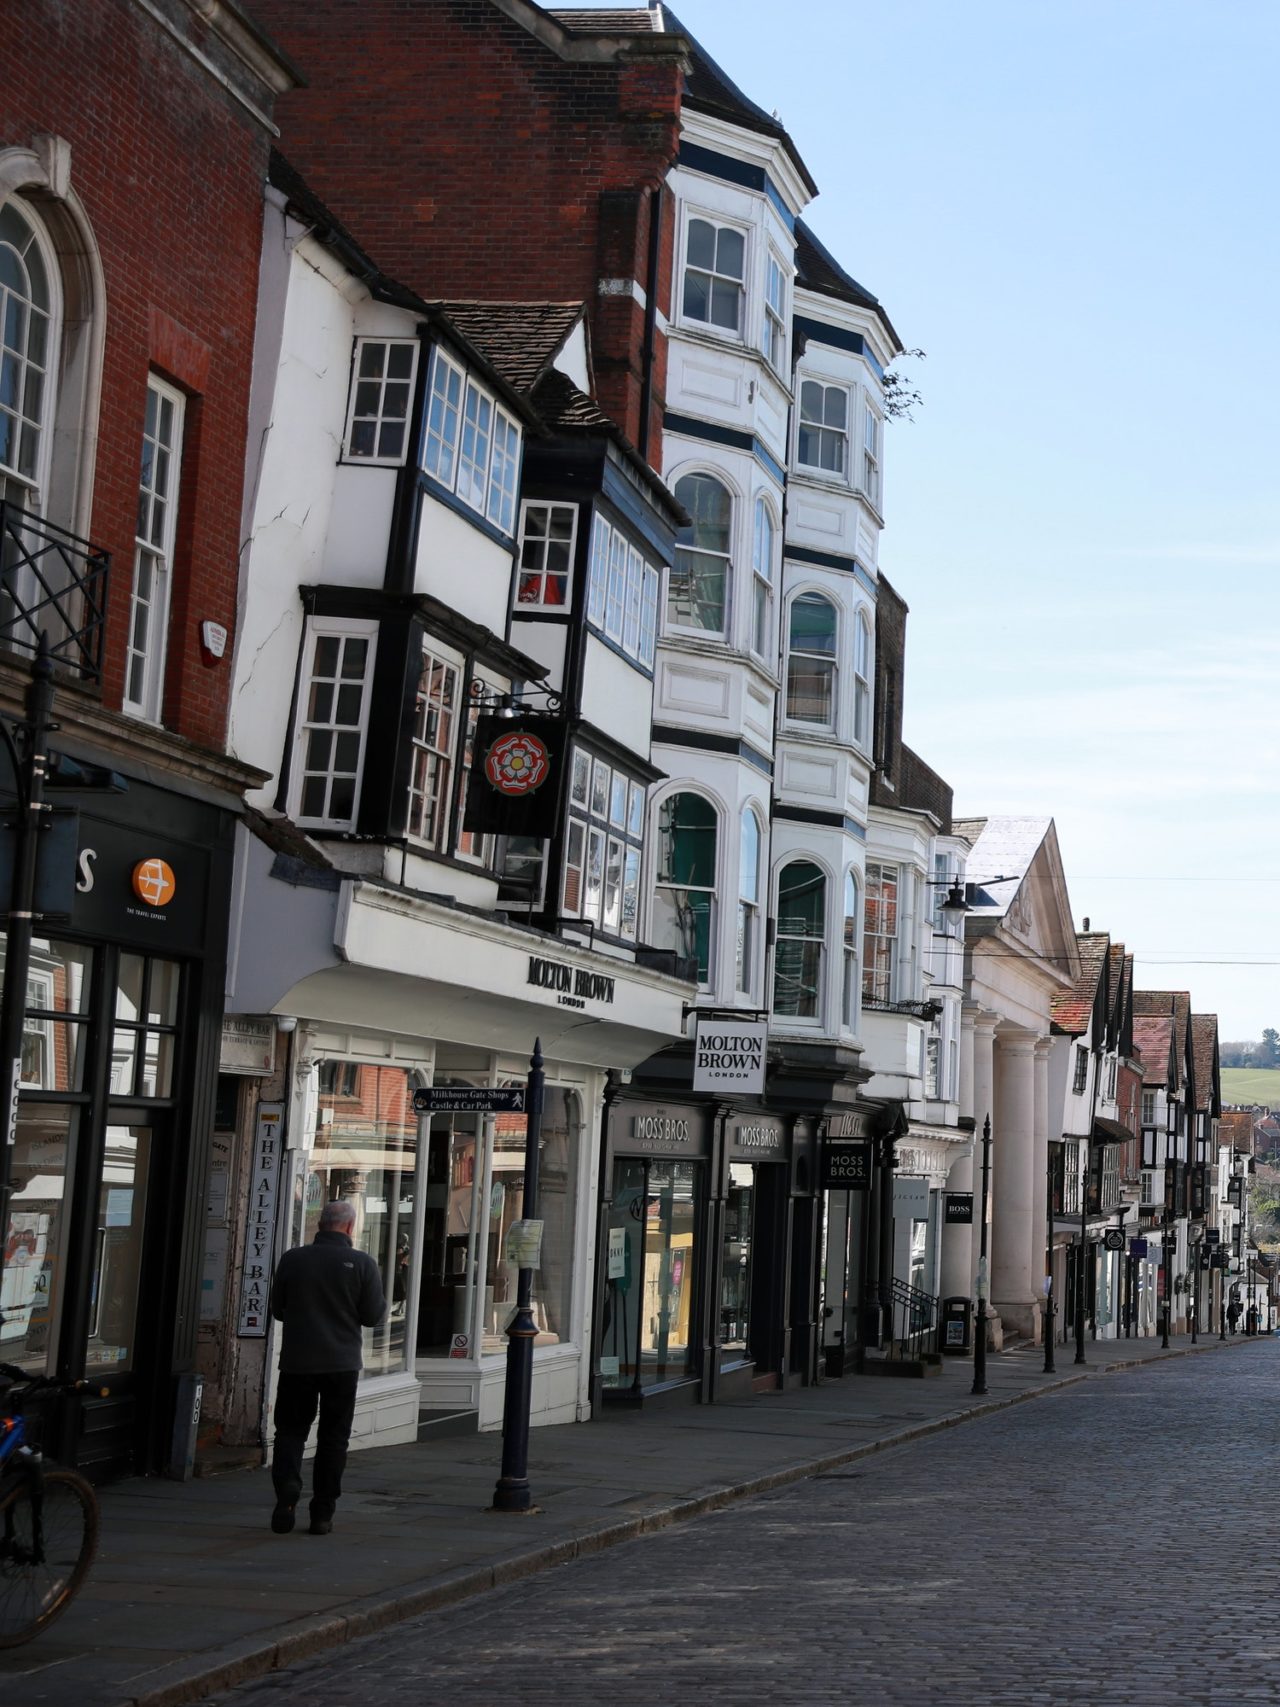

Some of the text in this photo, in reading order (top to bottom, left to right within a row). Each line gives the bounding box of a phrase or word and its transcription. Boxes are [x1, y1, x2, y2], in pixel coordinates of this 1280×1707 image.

[527, 956, 615, 1003] MOLTON BROWN
[699, 1035, 763, 1052] MOLTON
[697, 1053, 762, 1070] BROWN
[709, 1071, 749, 1079] LONDON
[430, 1090, 509, 1101] Milkhouse Gate Shops
[430, 1101, 493, 1110] Castle & Car Park
[636, 1116, 690, 1142] MOSS BROS.
[740, 1126, 760, 1146] MOSS
[260, 1123, 276, 1170] THE
[830, 1155, 864, 1166] MOSS
[830, 1166, 867, 1177] BROS.
[252, 1177, 271, 1258] ALLEY
[247, 1265, 264, 1312] BAR
